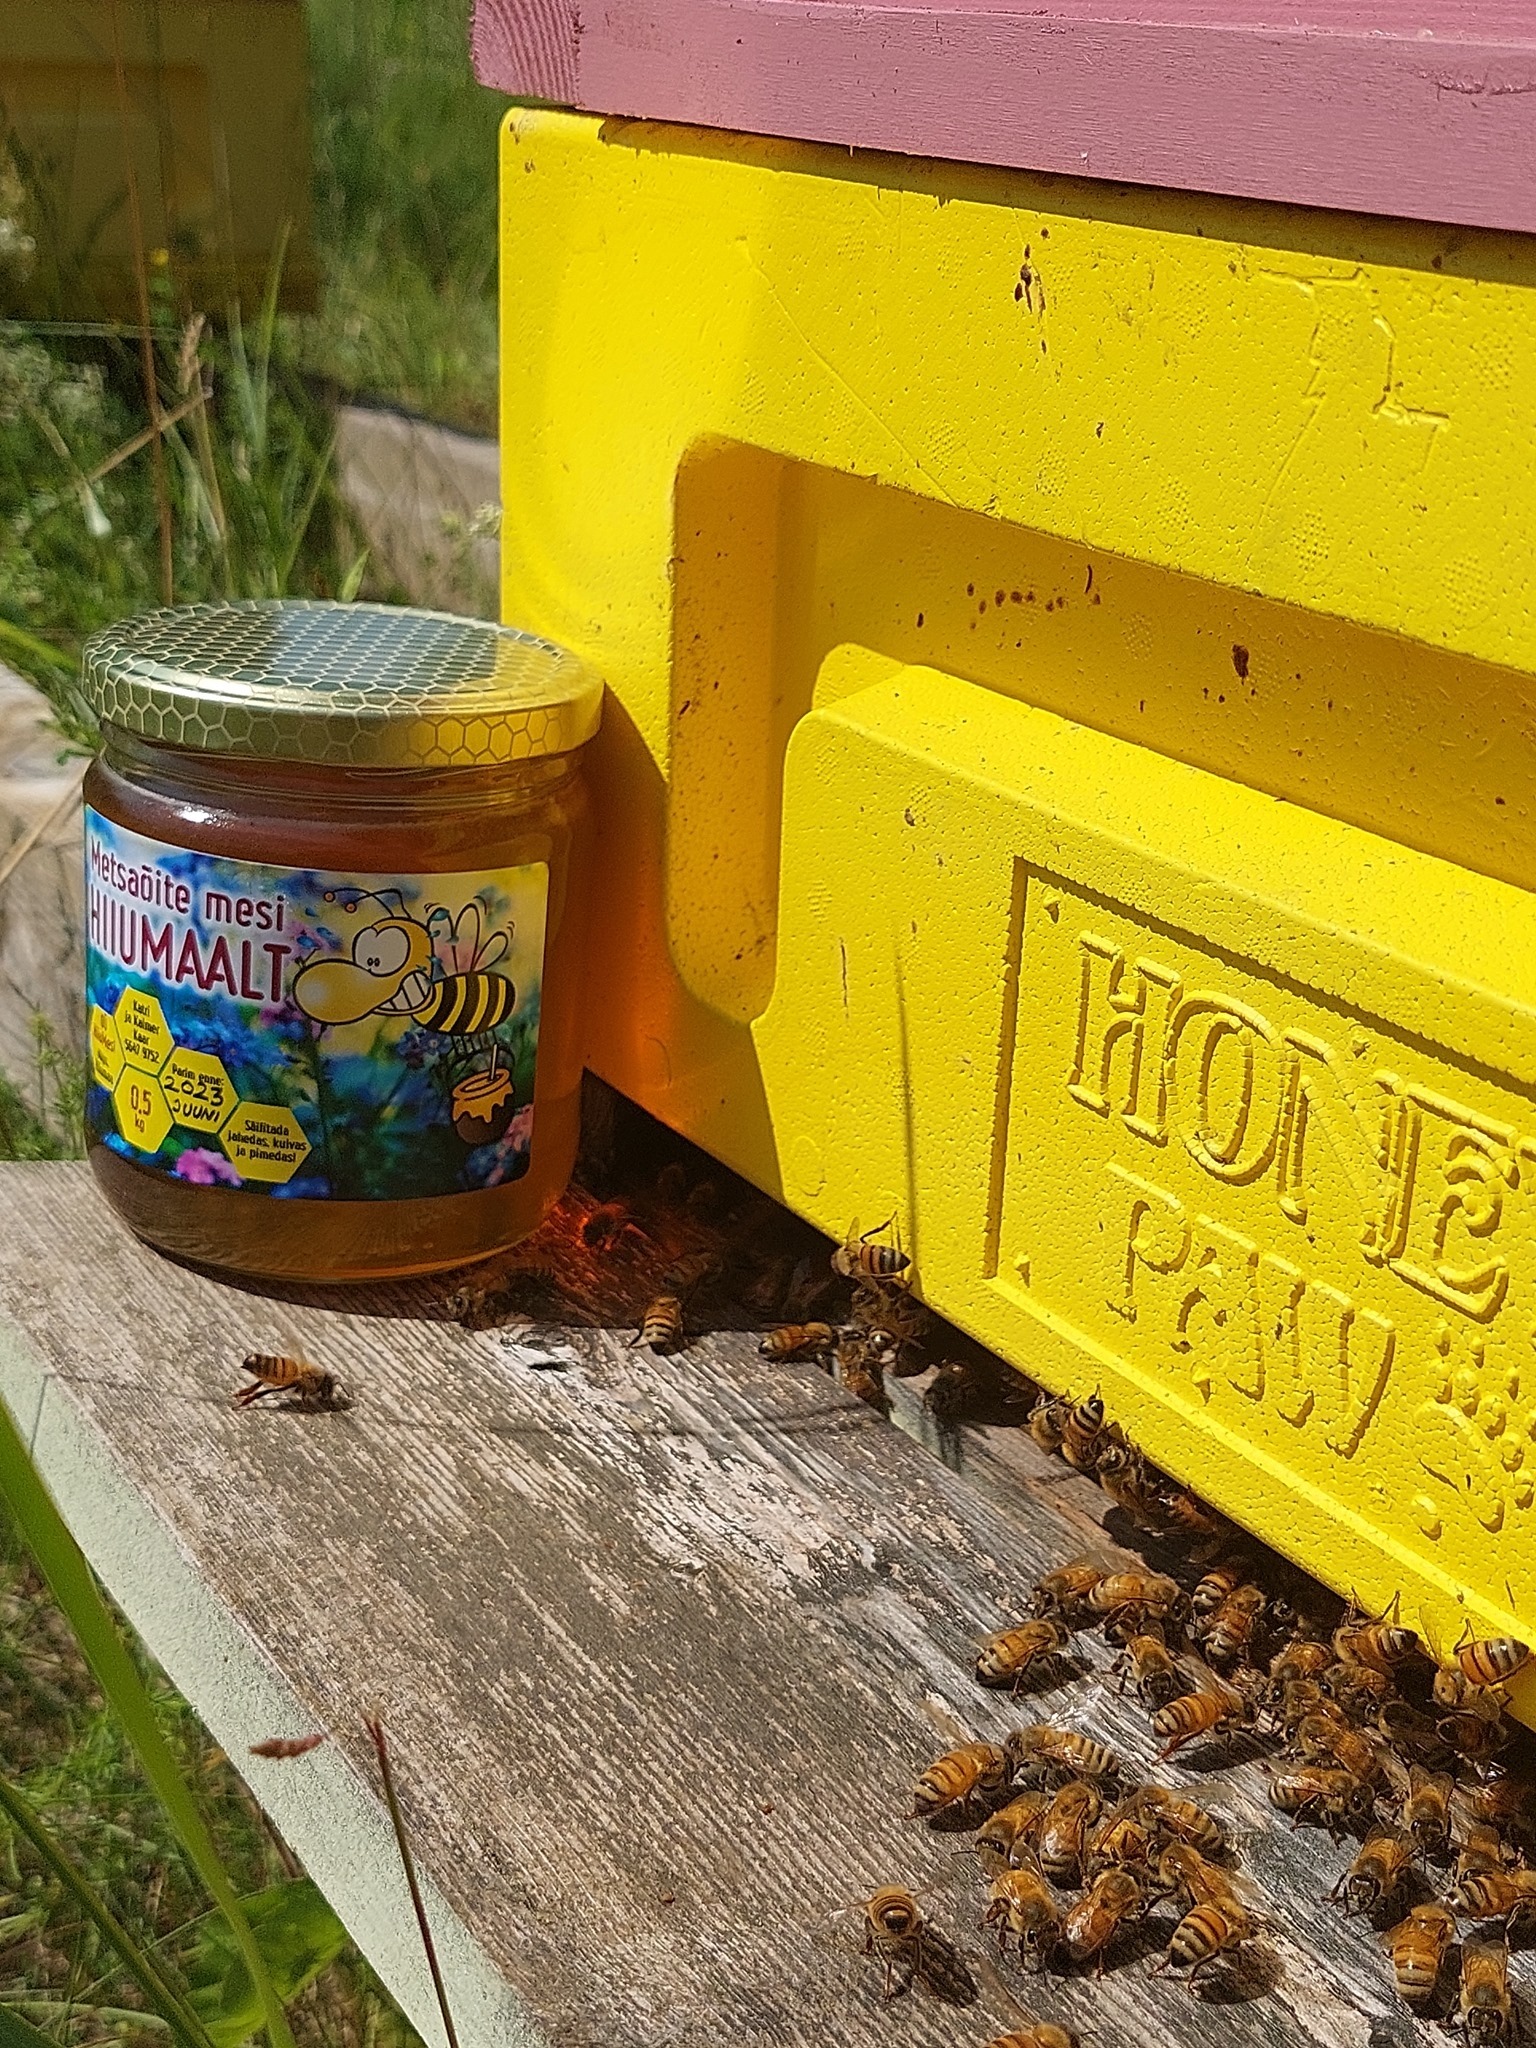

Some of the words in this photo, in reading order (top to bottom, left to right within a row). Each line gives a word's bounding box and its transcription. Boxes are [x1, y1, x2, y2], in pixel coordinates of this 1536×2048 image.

[91, 835, 190, 914] Metsaõite
[205, 891, 286, 931] mesi
[91, 884, 292, 1002] HIIUMAALT
[124, 1010, 131, 1024] ja
[172, 1063, 196, 1080] Parim
[164, 1076, 224, 1107] 2023
[172, 1098, 220, 1122] JUUNI
[134, 1113, 145, 1133] kg
[245, 1120, 290, 1136] Säilitada
[1066, 930, 1536, 1324] HONE
[236, 1145, 246, 1157] ja
[249, 1148, 297, 1162] pimedas!
[273, 1137, 307, 1151] kuivas
